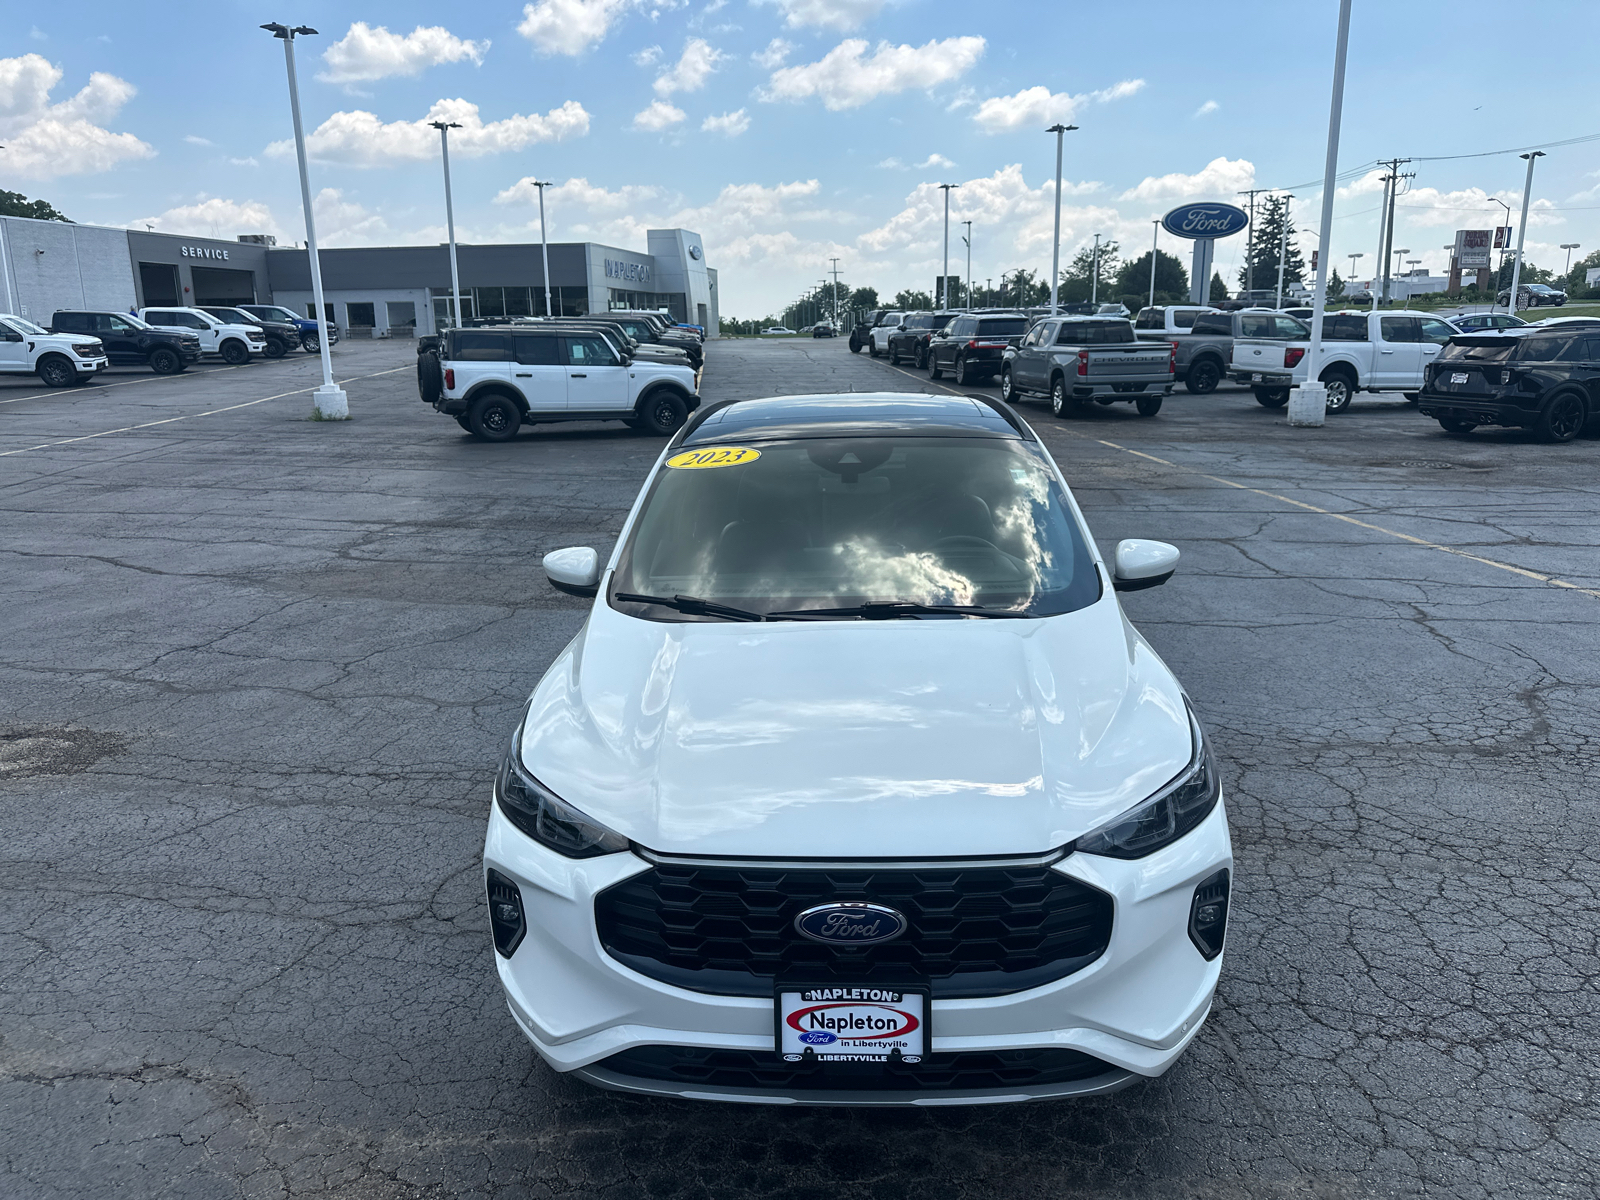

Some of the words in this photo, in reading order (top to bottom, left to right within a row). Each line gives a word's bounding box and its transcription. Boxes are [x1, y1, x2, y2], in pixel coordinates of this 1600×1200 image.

[1182, 209, 1233, 231] Ford
[181, 246, 229, 260] SERVICE
[605, 258, 651, 283] NAPLETON
[679, 450, 747, 466] 2023
[820, 912, 881, 937] Ford
[810, 988, 893, 1001] NAPLETON
[809, 1012, 898, 1033] Napleton
[806, 1033, 831, 1044] Ford
[840, 1039, 850, 1048] in
[852, 1040, 908, 1049] Libertyville
